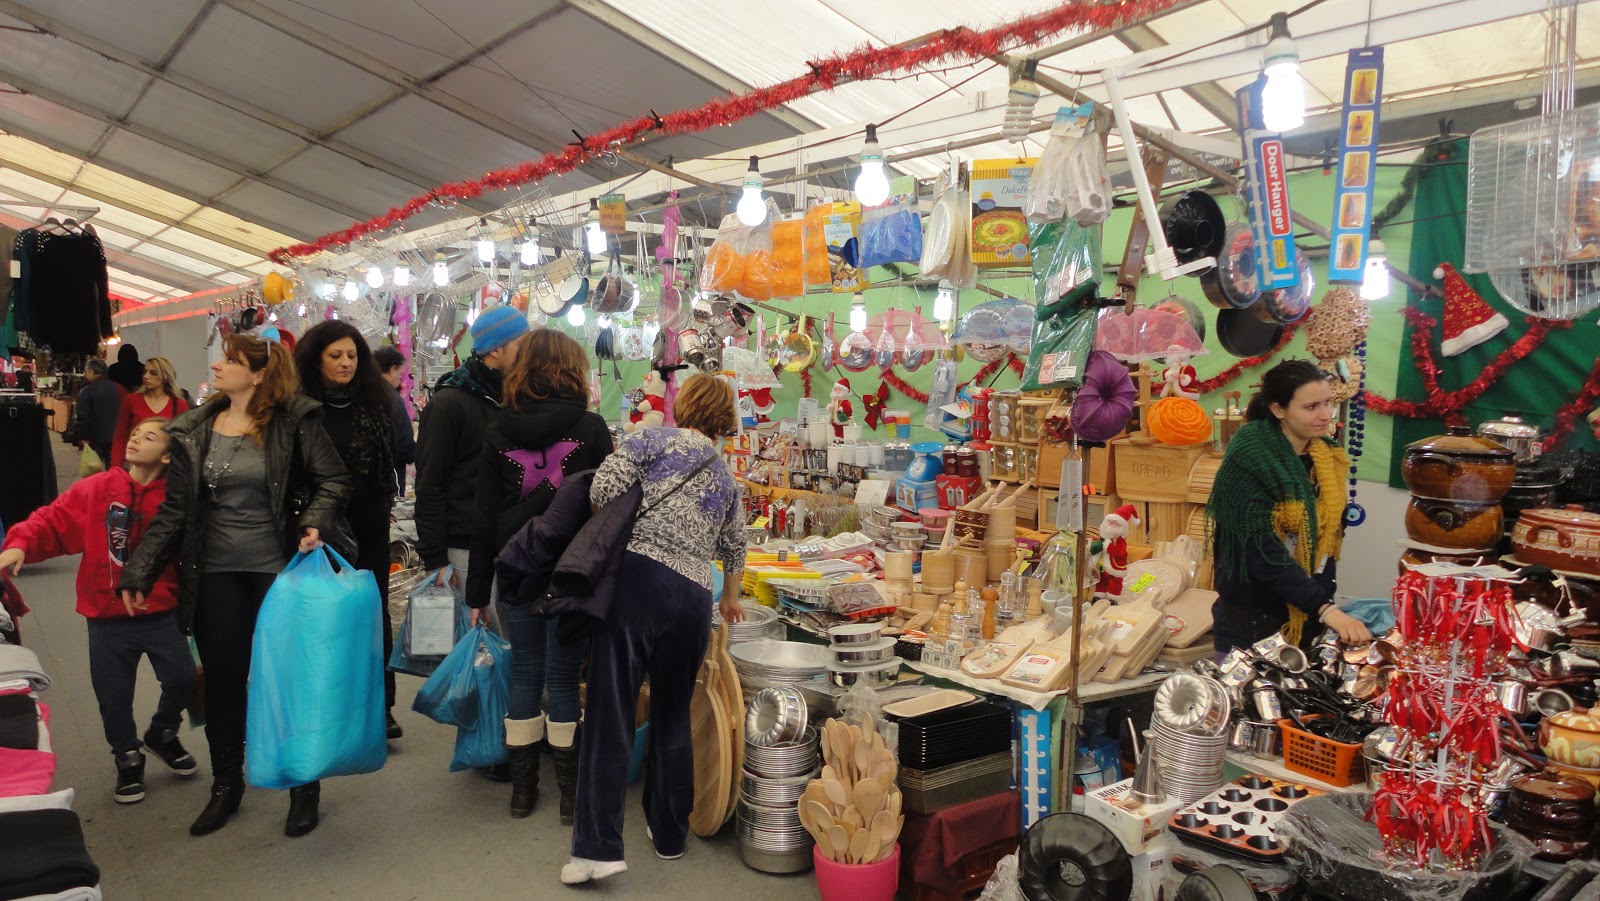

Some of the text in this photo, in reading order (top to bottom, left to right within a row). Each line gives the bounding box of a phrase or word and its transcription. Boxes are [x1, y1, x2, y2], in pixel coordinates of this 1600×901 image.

[1266, 145, 1278, 181] Door
[1270, 181, 1285, 231] Hanger
[1132, 463, 1170, 479] BREAD
